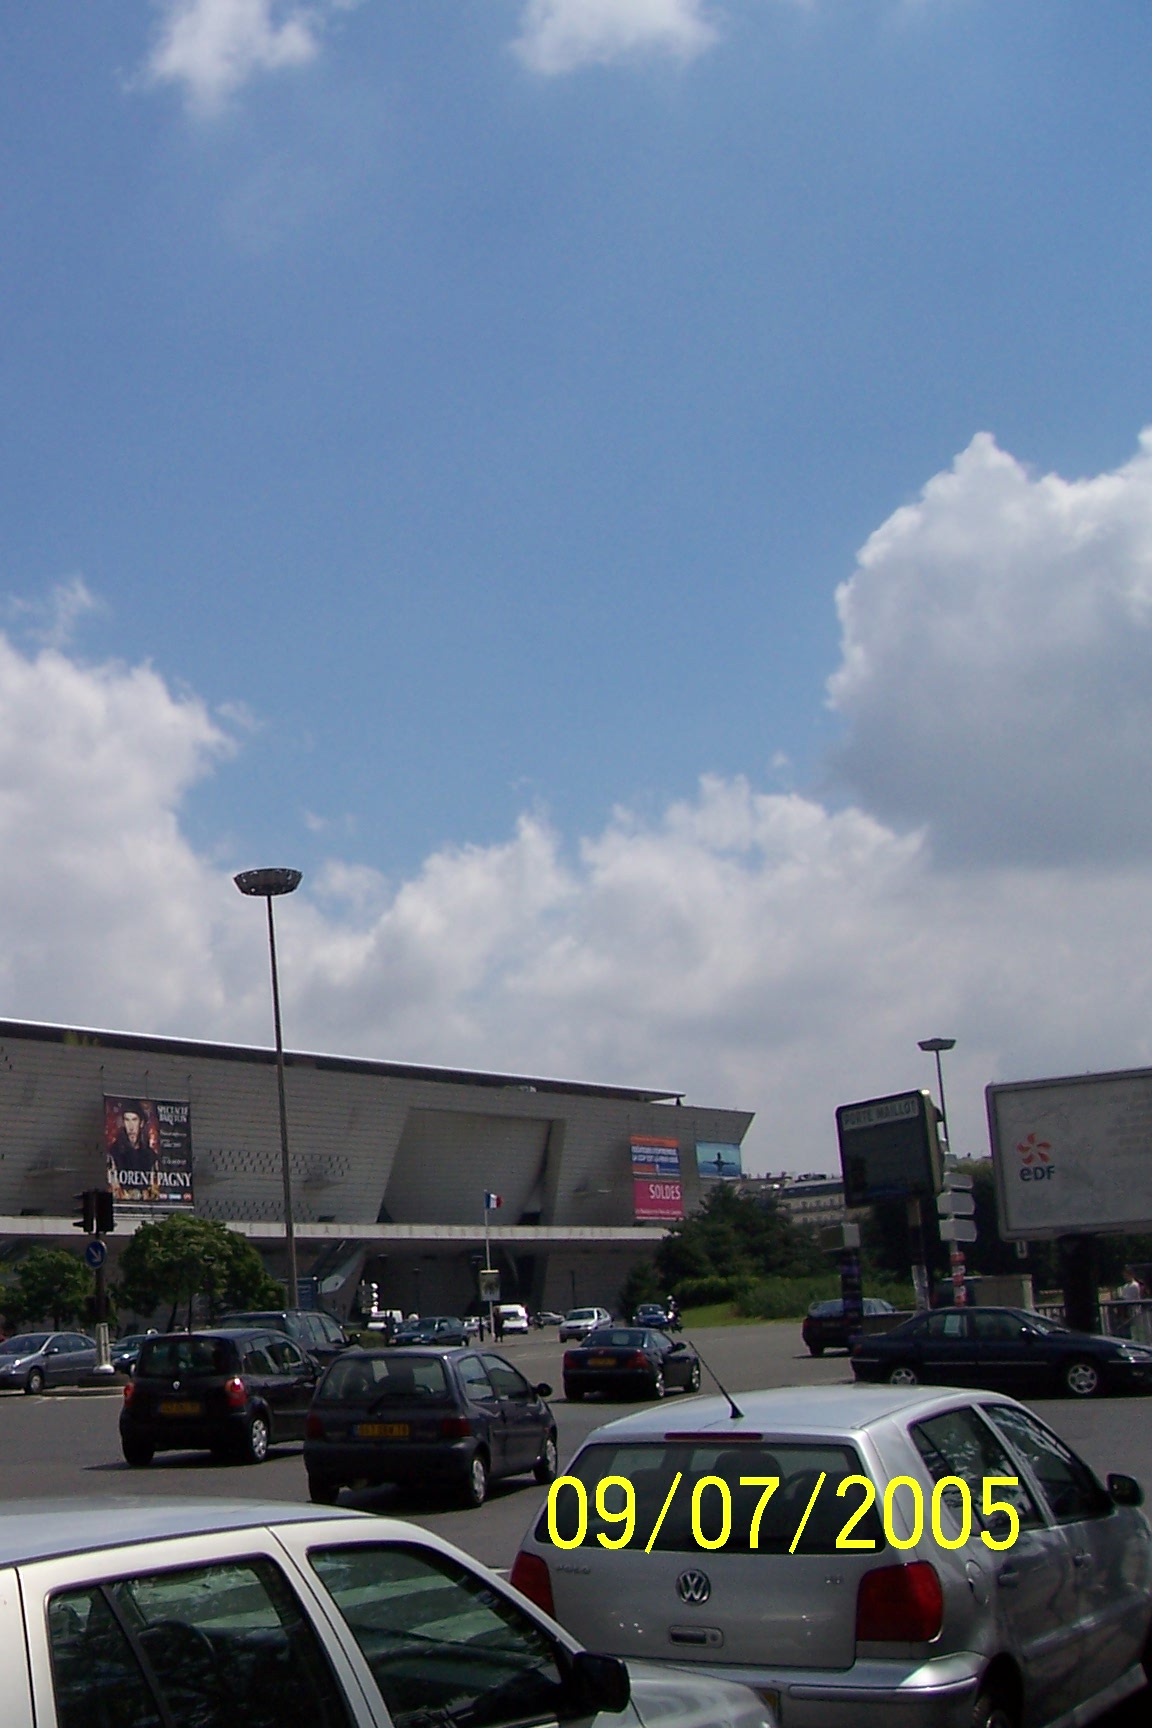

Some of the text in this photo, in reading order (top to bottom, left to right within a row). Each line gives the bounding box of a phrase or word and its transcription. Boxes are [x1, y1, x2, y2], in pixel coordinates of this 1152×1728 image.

[876, 1099, 916, 1119] MAILLOT
[108, 1170, 191, 1187] FLORENT PAGNY
[649, 1184, 680, 1199] SOLDES
